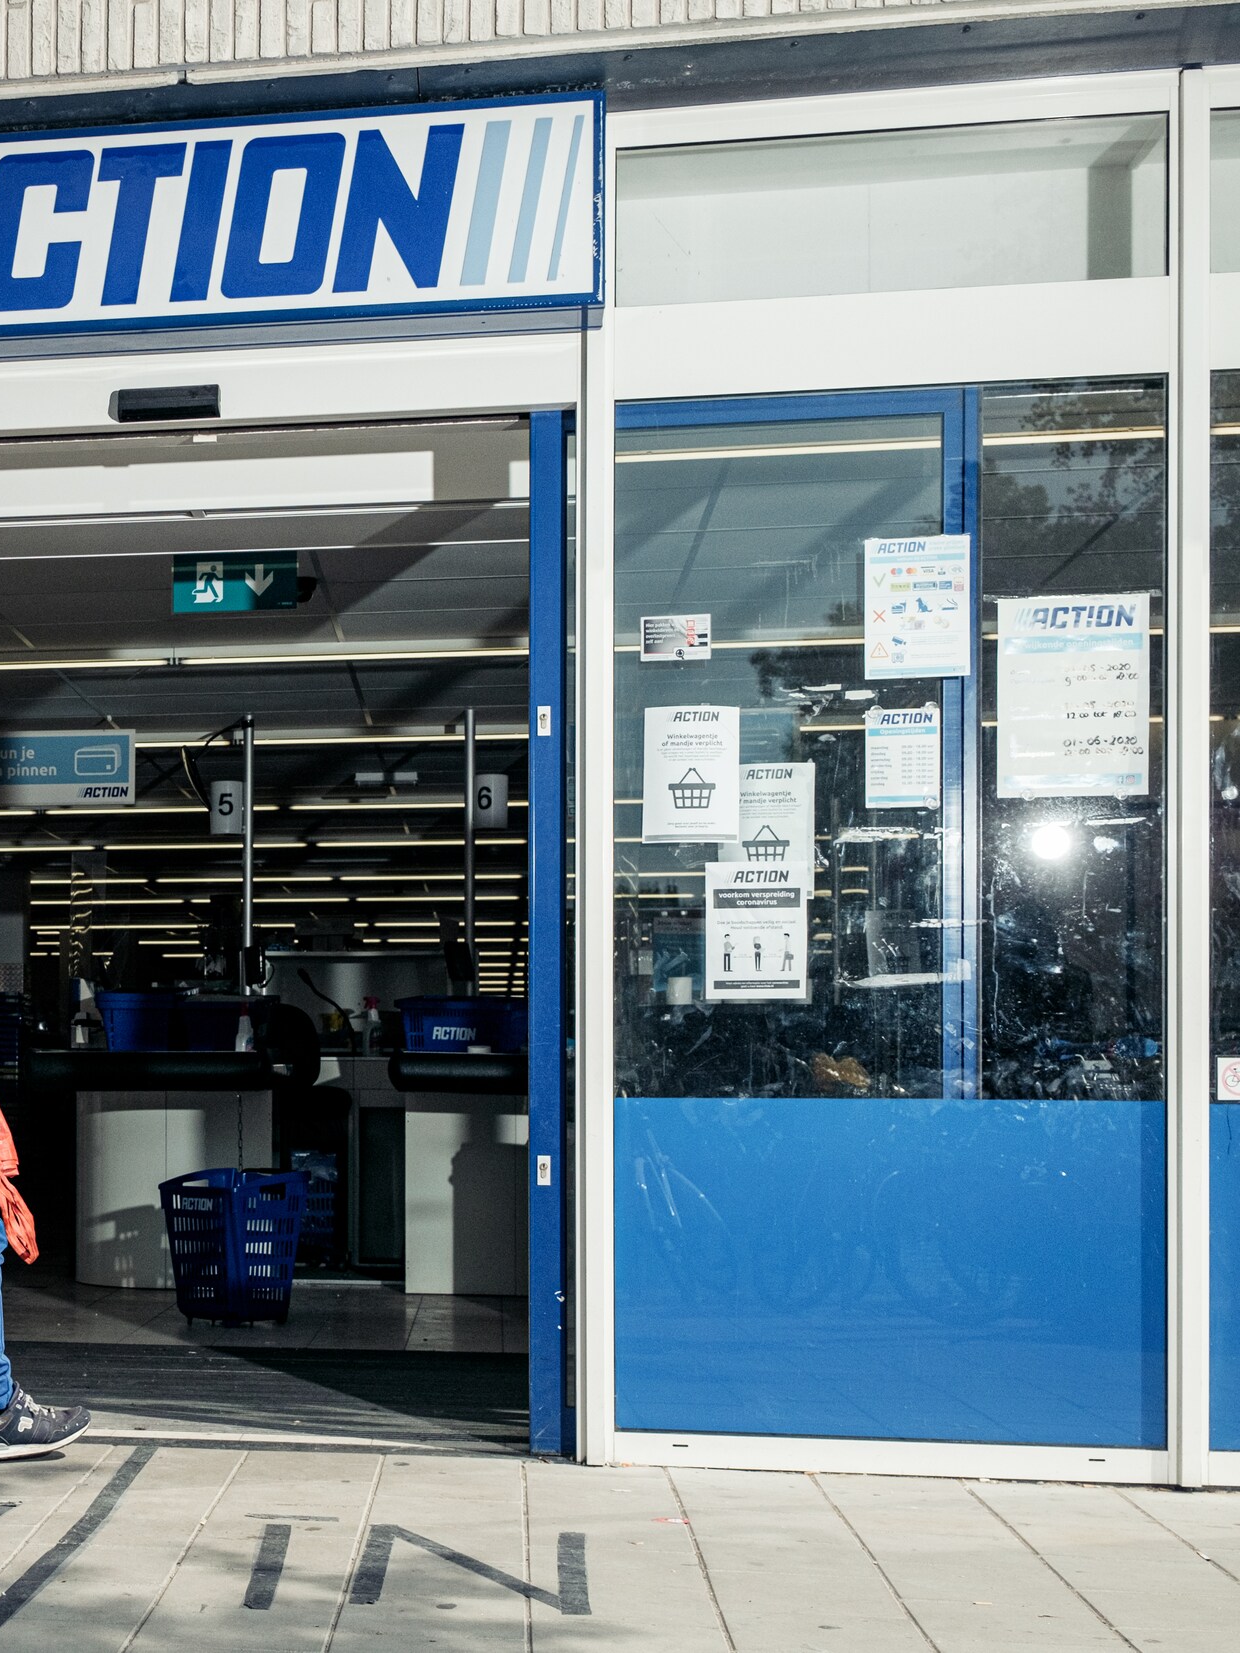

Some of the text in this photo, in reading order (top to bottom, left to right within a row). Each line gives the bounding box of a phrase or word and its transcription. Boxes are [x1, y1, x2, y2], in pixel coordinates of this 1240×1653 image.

[877, 541, 927, 554] ACTION
[673, 711, 720, 722] ACTION
[880, 712, 933, 725] ACTION
[880, 728, 926, 736] Openingstijden
[20, 745, 35, 763] je
[7, 764, 57, 780] pinnen
[746, 768, 793, 780] ACTION
[84, 786, 129, 798] ACTION
[477, 786, 493, 810] 6
[740, 790, 791, 798] Winkelwagentje
[218, 792, 234, 816] 5
[768, 797, 797, 805] verplicht
[733, 870, 789, 883] ACTION
[719, 890, 795, 899] voorkom verspreiding
[736, 898, 778, 906] coronavirus
[432, 1026, 476, 1041] ACTION
[182, 1197, 214, 1211] ACTION
